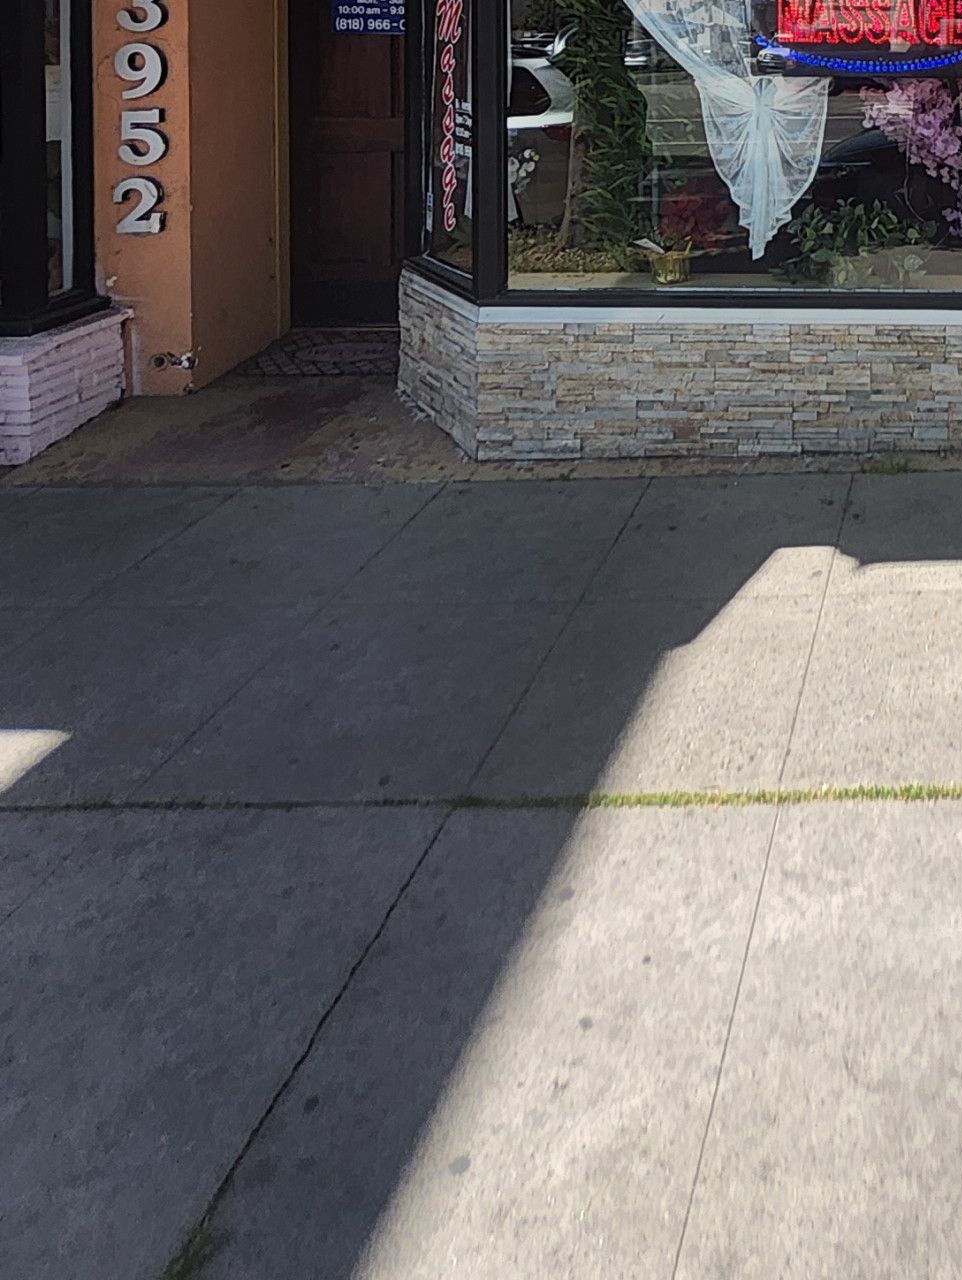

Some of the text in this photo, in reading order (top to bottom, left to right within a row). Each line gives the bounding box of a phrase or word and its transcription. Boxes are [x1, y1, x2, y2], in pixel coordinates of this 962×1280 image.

[337, 5, 365, 15] 10:00
[365, 7, 381, 15] am
[335, 17, 365, 32] (818)
